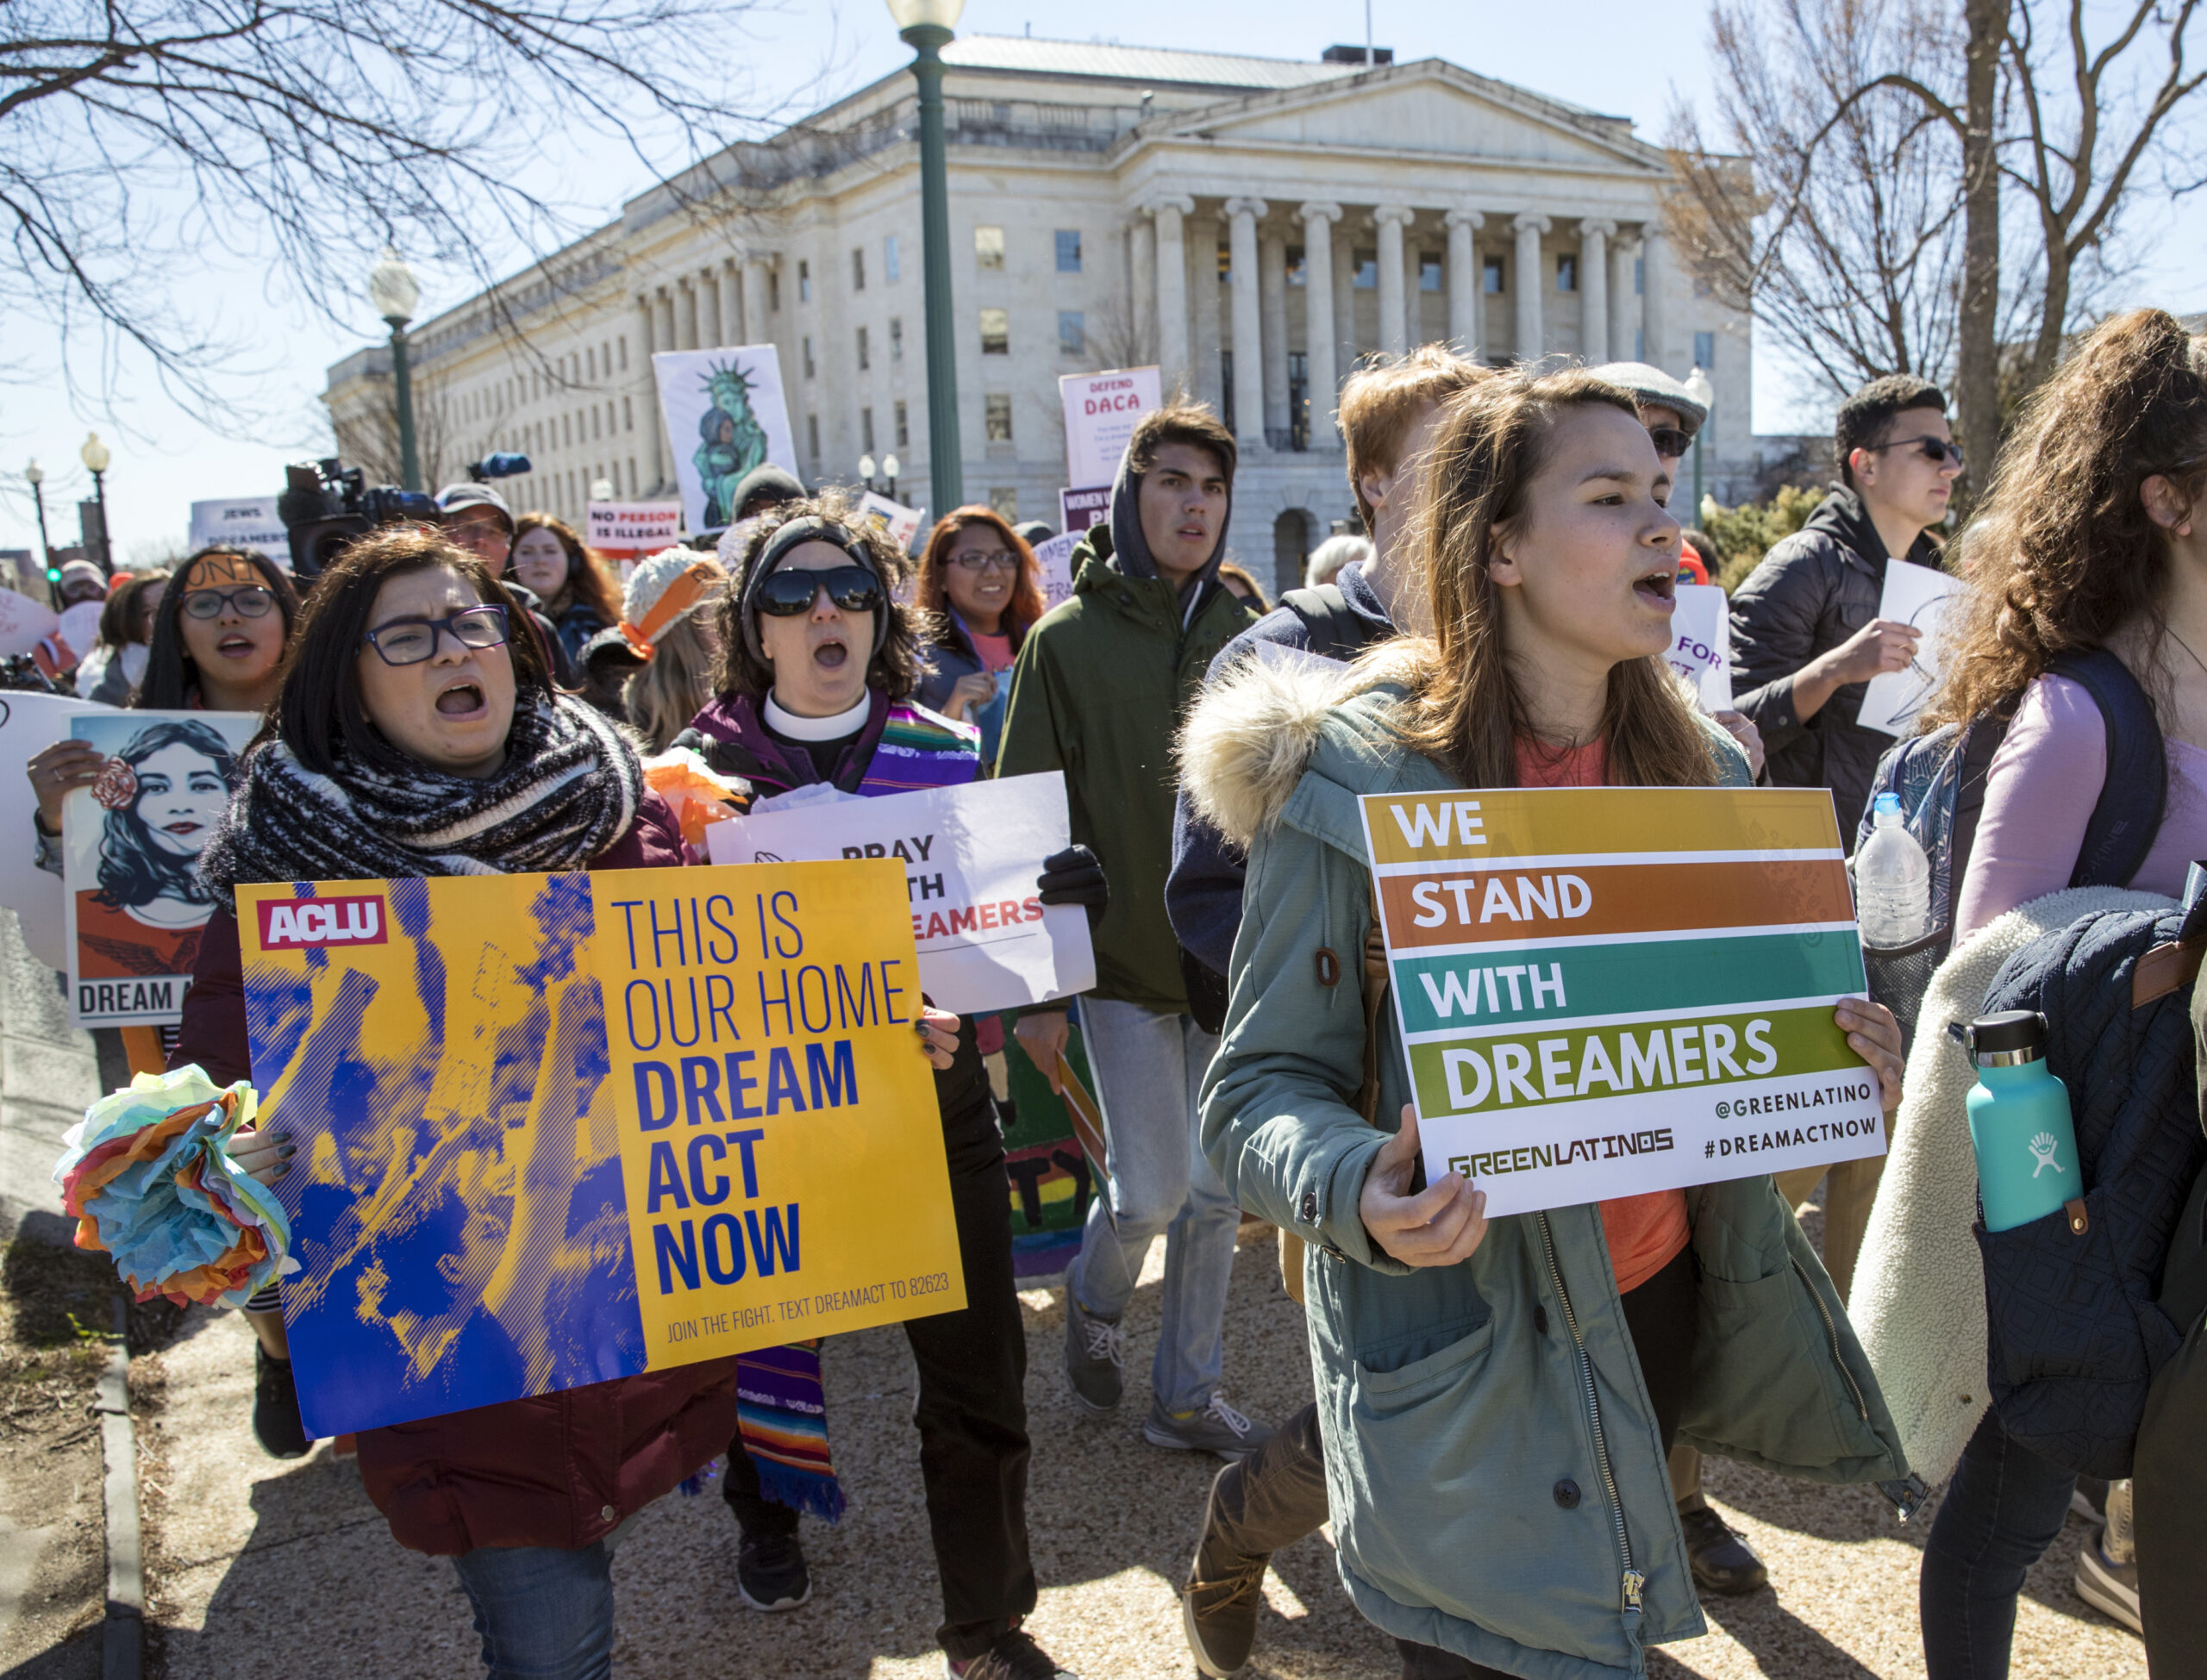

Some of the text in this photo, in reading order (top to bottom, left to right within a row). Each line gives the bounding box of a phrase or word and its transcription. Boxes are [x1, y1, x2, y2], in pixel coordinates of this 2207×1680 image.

[1085, 394, 1140, 415] DACA
[1090, 379, 1134, 393] DEFEND
[223, 508, 262, 521] JEWS
[591, 512, 678, 522] NO PERSON
[1065, 491, 1104, 511] WOMEN
[596, 527, 672, 538] IS ILLEGAL
[1677, 635, 1722, 671] FOR
[1389, 800, 1487, 849] WE
[267, 902, 378, 943] ACLU
[912, 897, 1044, 940] EAMERS
[1411, 874, 1592, 928] STAND
[611, 890, 803, 970] THIS IS
[78, 981, 172, 1014] DREAM
[625, 959, 910, 1052] OUR HOME
[1418, 962, 1566, 1018] WITH
[633, 1039, 860, 1132] DREAM
[1441, 1018, 1778, 1110] DREAMERS
[1715, 1083, 1872, 1120] @GREENLATINO
[1447, 1127, 1674, 1179] GREENLATINOS
[1704, 1116, 1877, 1159] #DREAMACTNOW
[647, 1127, 765, 1215] ACT
[653, 1202, 800, 1296] NOW
[667, 1271, 949, 1344] JOIN THE FIGHT. TEXT DREAMACT TO 82623
